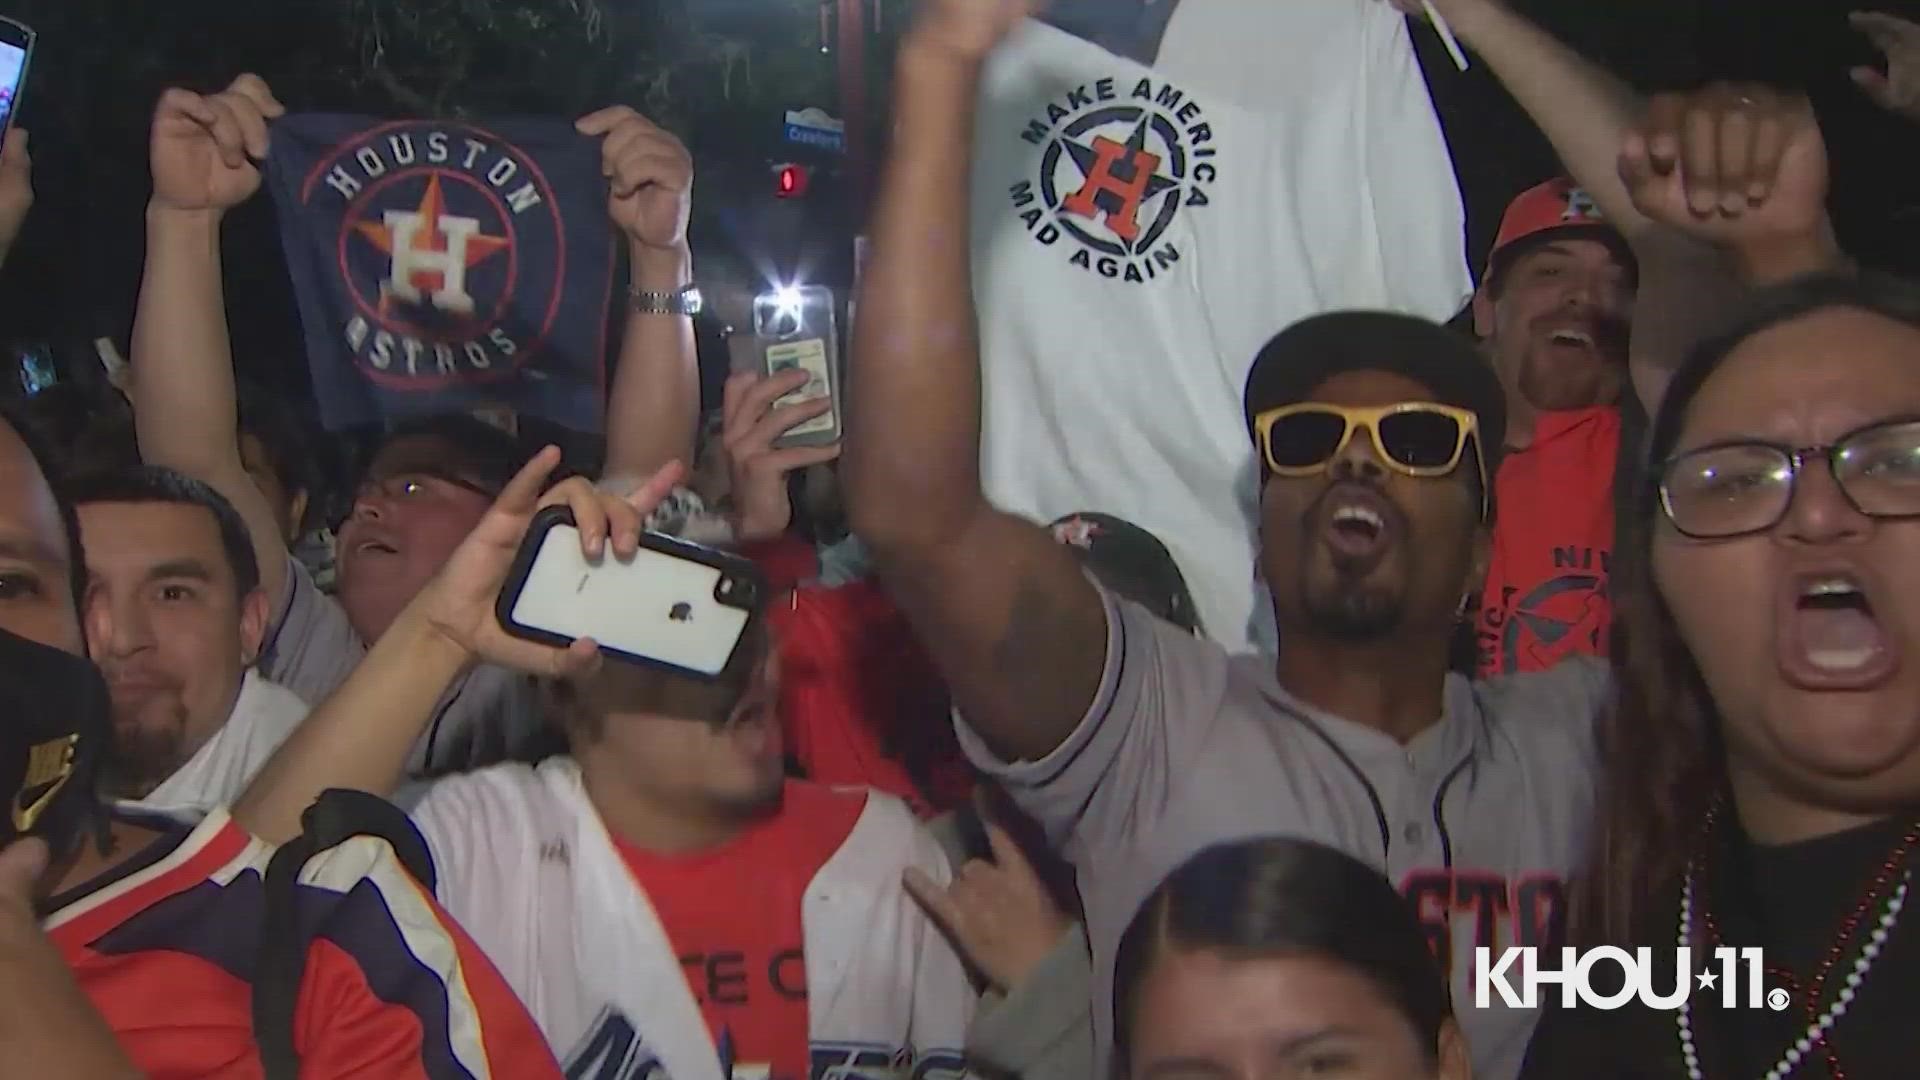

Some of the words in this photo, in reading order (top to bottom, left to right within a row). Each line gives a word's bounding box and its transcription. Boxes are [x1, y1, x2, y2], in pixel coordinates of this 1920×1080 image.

[326, 132, 541, 214] HOUSTON
[1020, 77, 1116, 145] MAKE
[1132, 78, 1216, 207] AMERICA
[1063, 134, 1161, 240] H
[383, 209, 480, 312] H
[1009, 180, 1060, 245] MAD
[1069, 242, 1181, 283] AGAIN
[345, 315, 517, 377] ASTROS
